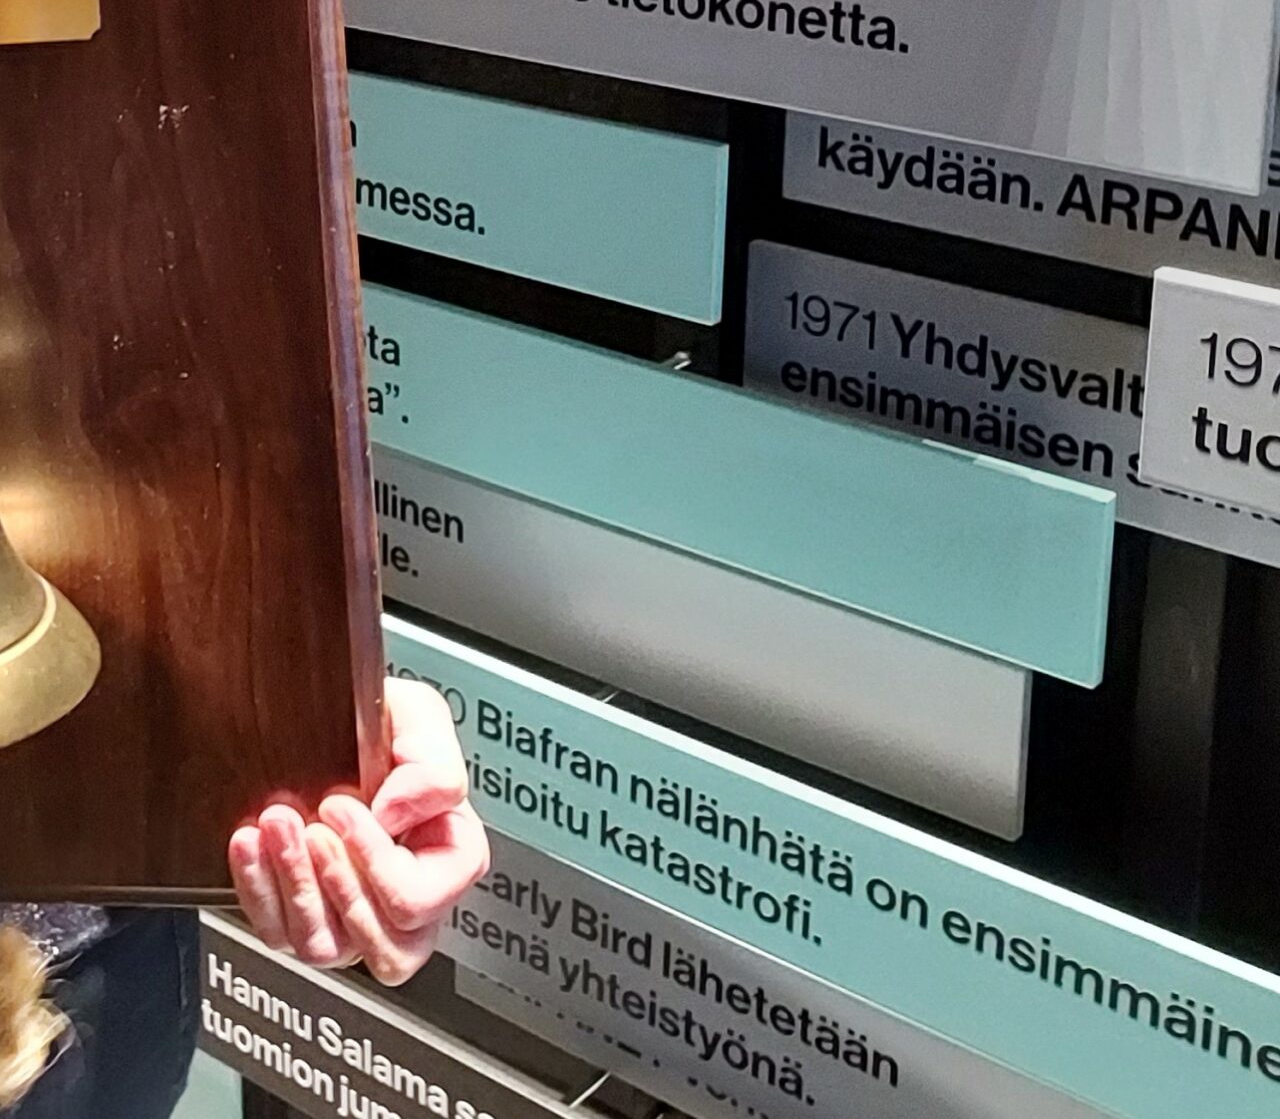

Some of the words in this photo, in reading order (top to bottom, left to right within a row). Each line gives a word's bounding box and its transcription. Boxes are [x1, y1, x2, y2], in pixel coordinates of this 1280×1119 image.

[817, 125, 1045, 213] käydään.
[1056, 173, 1280, 261] ARPAN
[780, 359, 1114, 479] ensimmäisen
[784, 290, 877, 350] 1971
[888, 311, 1147, 419] Yhdysvalt
[476, 698, 619, 794] Biafran
[629, 770, 854, 896] nälänhätä
[866, 877, 929, 929] on
[599, 809, 823, 946] katastrofi.
[200, 998, 335, 1103] tuomion
[207, 952, 313, 1042] Hannu
[317, 1015, 449, 1119] Salama
[559, 956, 815, 1107] yhteistyönä.
[571, 897, 653, 969] Bird
[662, 941, 899, 1089] lähetetään
